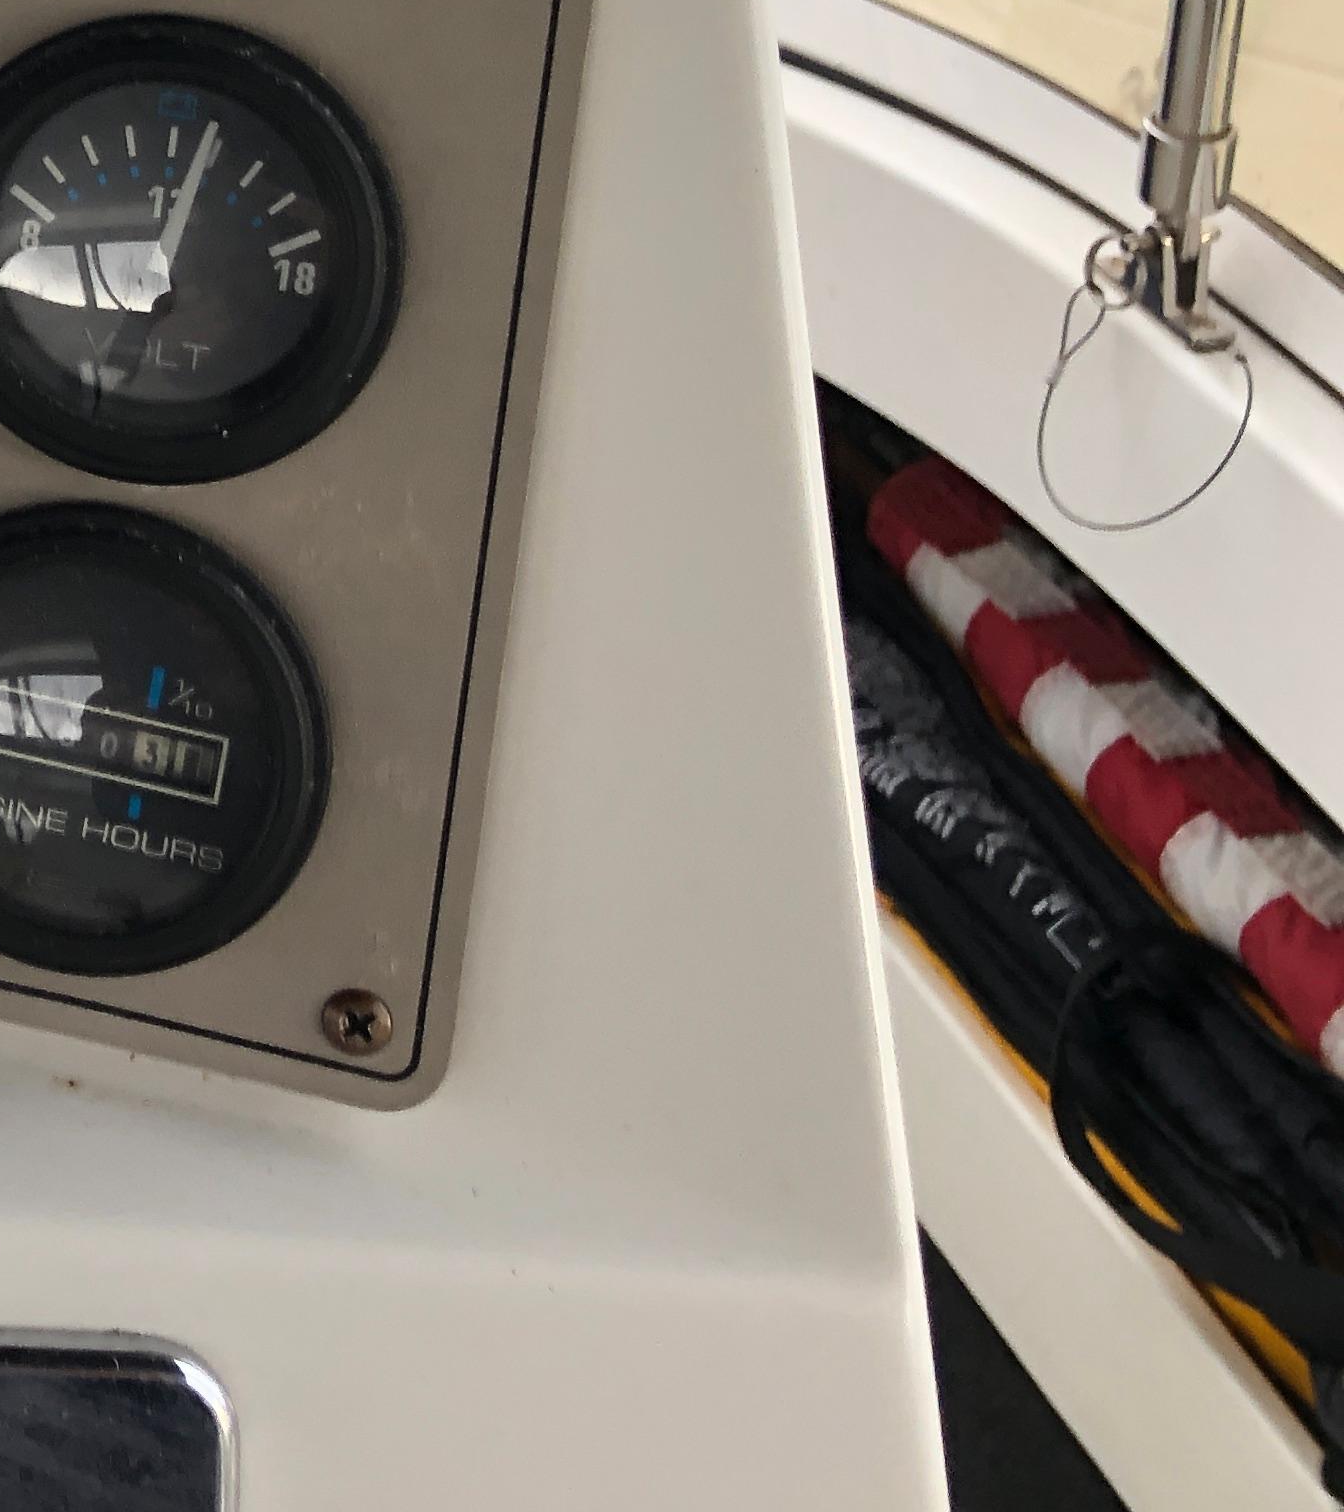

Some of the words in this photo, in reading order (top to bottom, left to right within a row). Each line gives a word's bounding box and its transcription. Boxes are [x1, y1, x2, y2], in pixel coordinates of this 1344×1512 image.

[20, 219, 41, 250] 8
[273, 258, 316, 296] 18
[85, 328, 212, 371] VLT
[81, 816, 224, 873] HOURS
